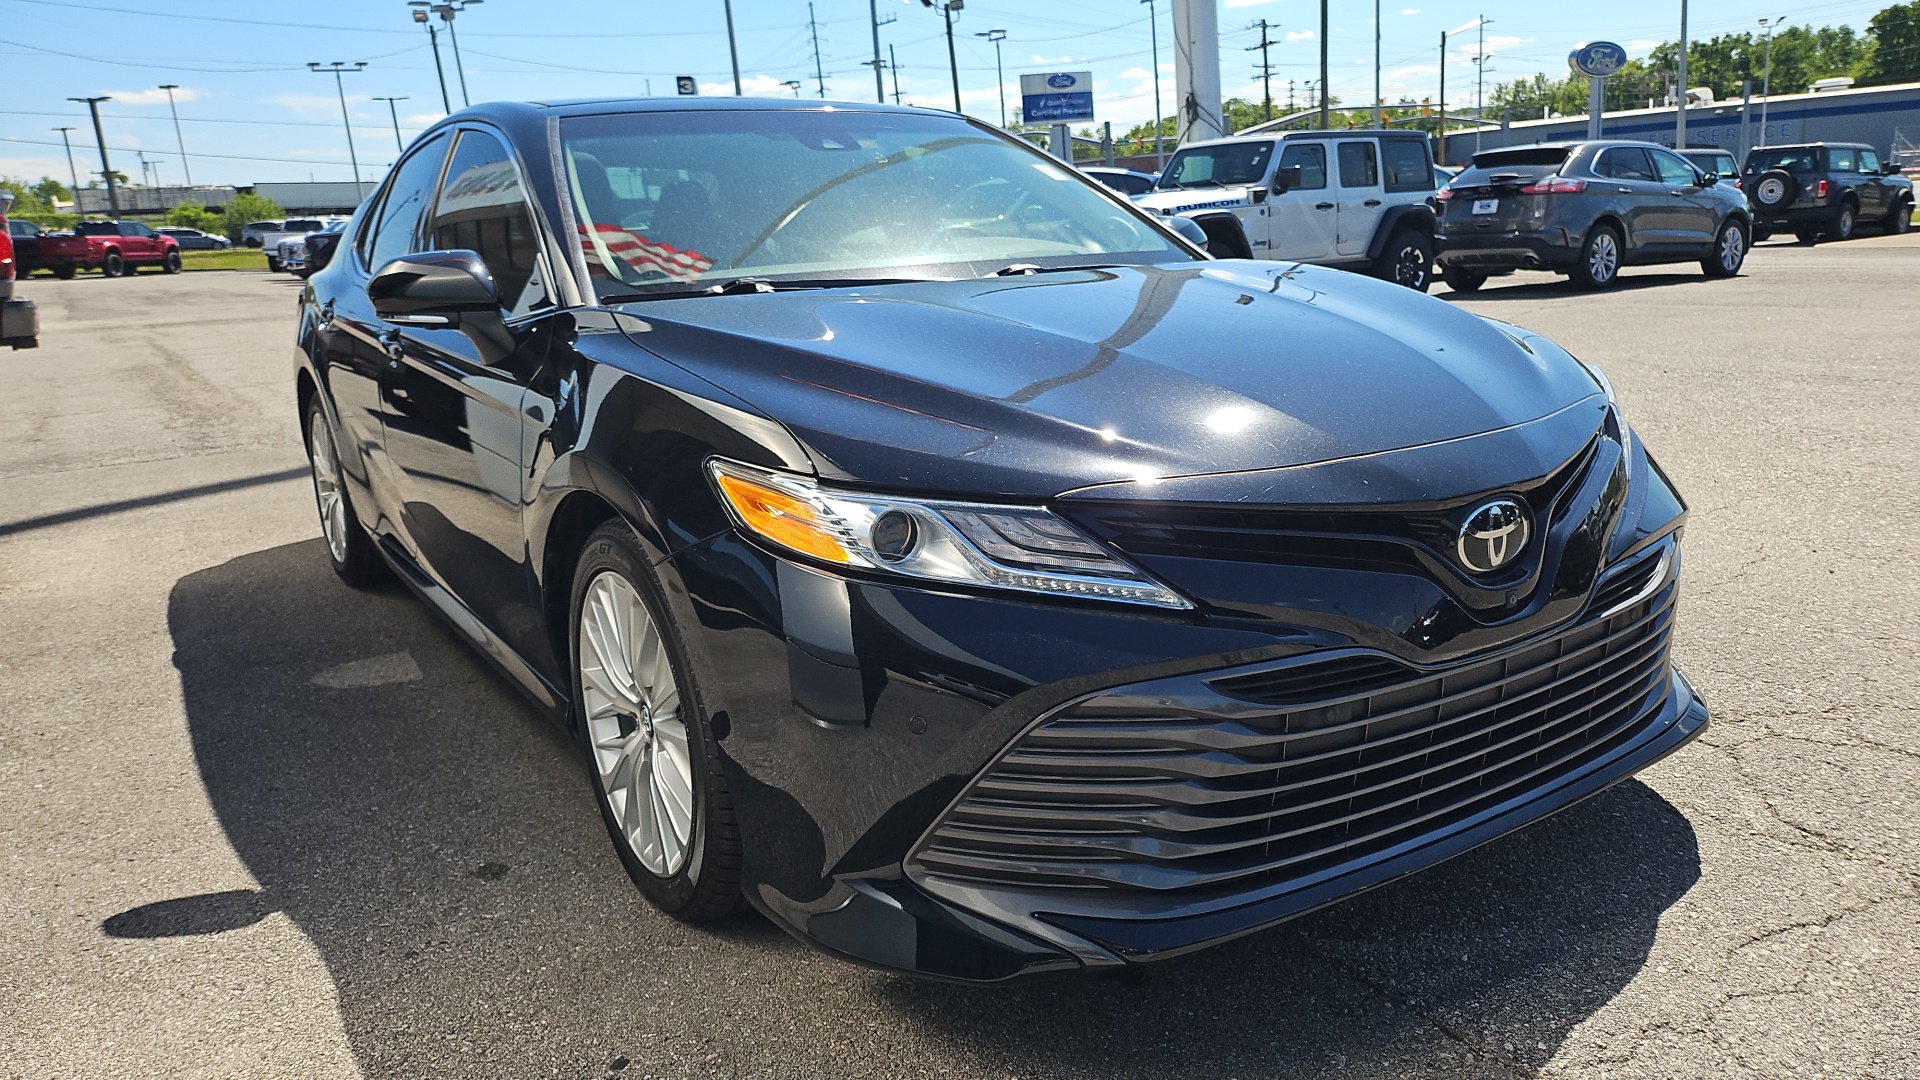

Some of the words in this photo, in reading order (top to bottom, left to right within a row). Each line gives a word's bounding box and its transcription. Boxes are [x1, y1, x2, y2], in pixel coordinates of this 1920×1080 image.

[1587, 48, 1618, 69] Ford
[679, 79, 692, 93] 3
[1053, 76, 1072, 87] Ford
[1697, 123, 1791, 143] SERICE
[1176, 199, 1240, 211] RUBICON
[599, 543, 613, 555] GT
